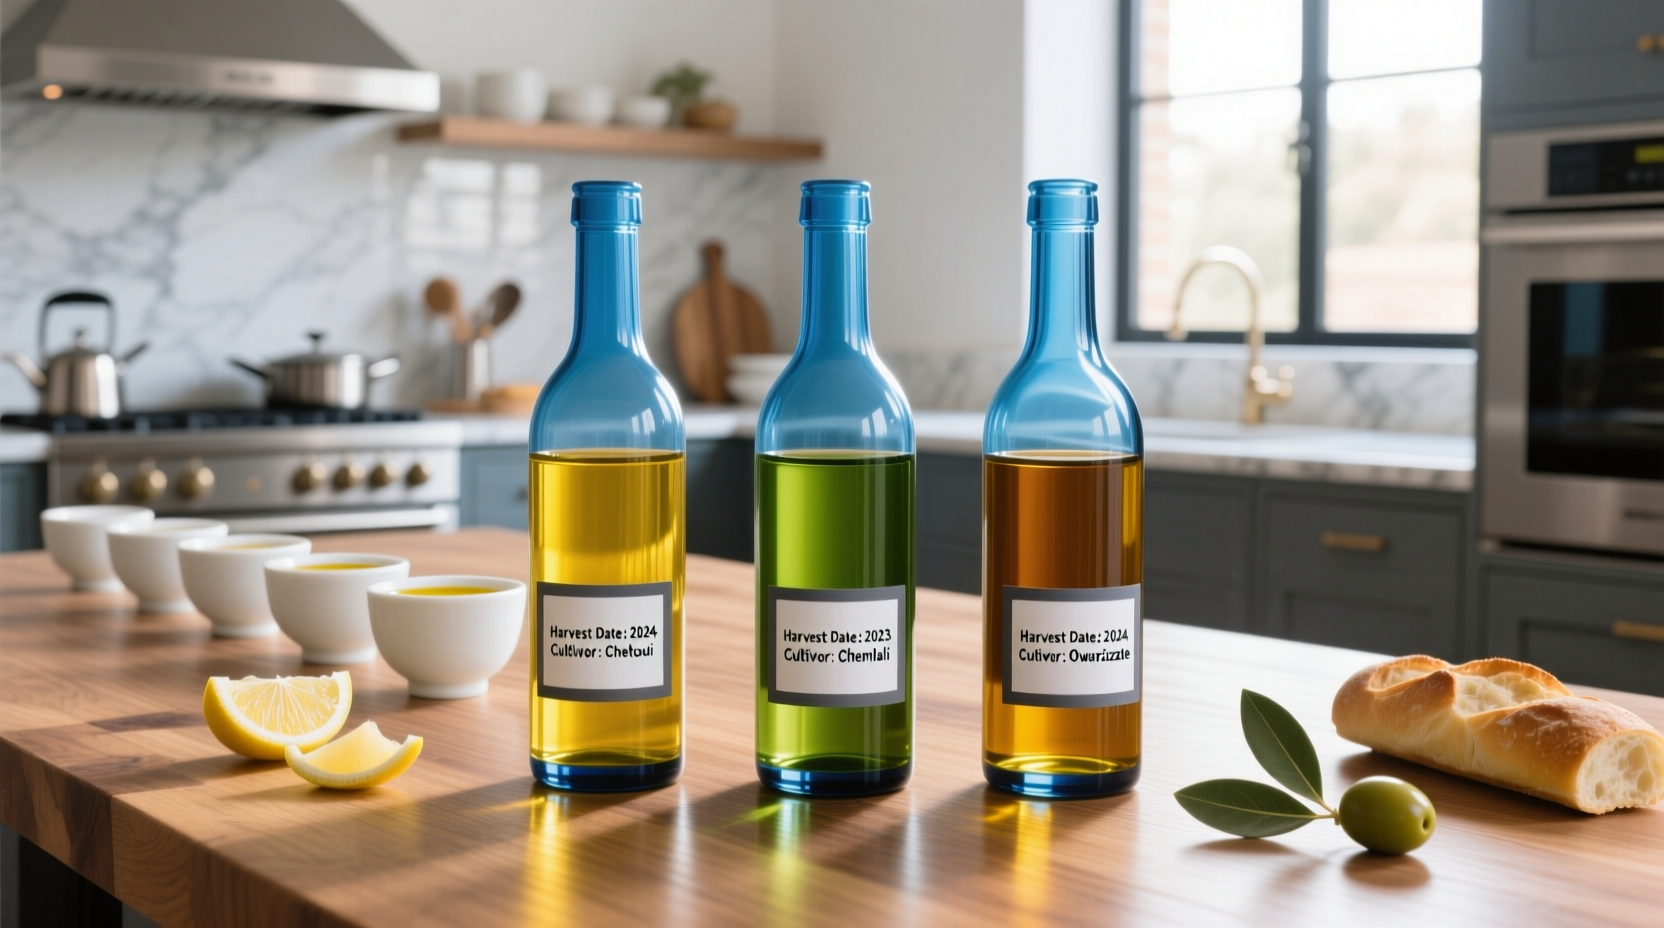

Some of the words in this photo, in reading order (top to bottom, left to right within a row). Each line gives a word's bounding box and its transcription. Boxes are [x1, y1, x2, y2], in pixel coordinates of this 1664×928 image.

[550, 625, 593, 640] Harvest
[595, 626, 627, 640] Date:
[629, 624, 658, 639] 2024
[783, 629, 828, 643] Harvest
[830, 630, 862, 643] Date:
[864, 628, 892, 643] 2023
[1020, 629, 1067, 644] Harvest
[1069, 630, 1101, 644] Date:
[1103, 628, 1129, 643] 2024
[838, 646, 890, 663] Chemlali
